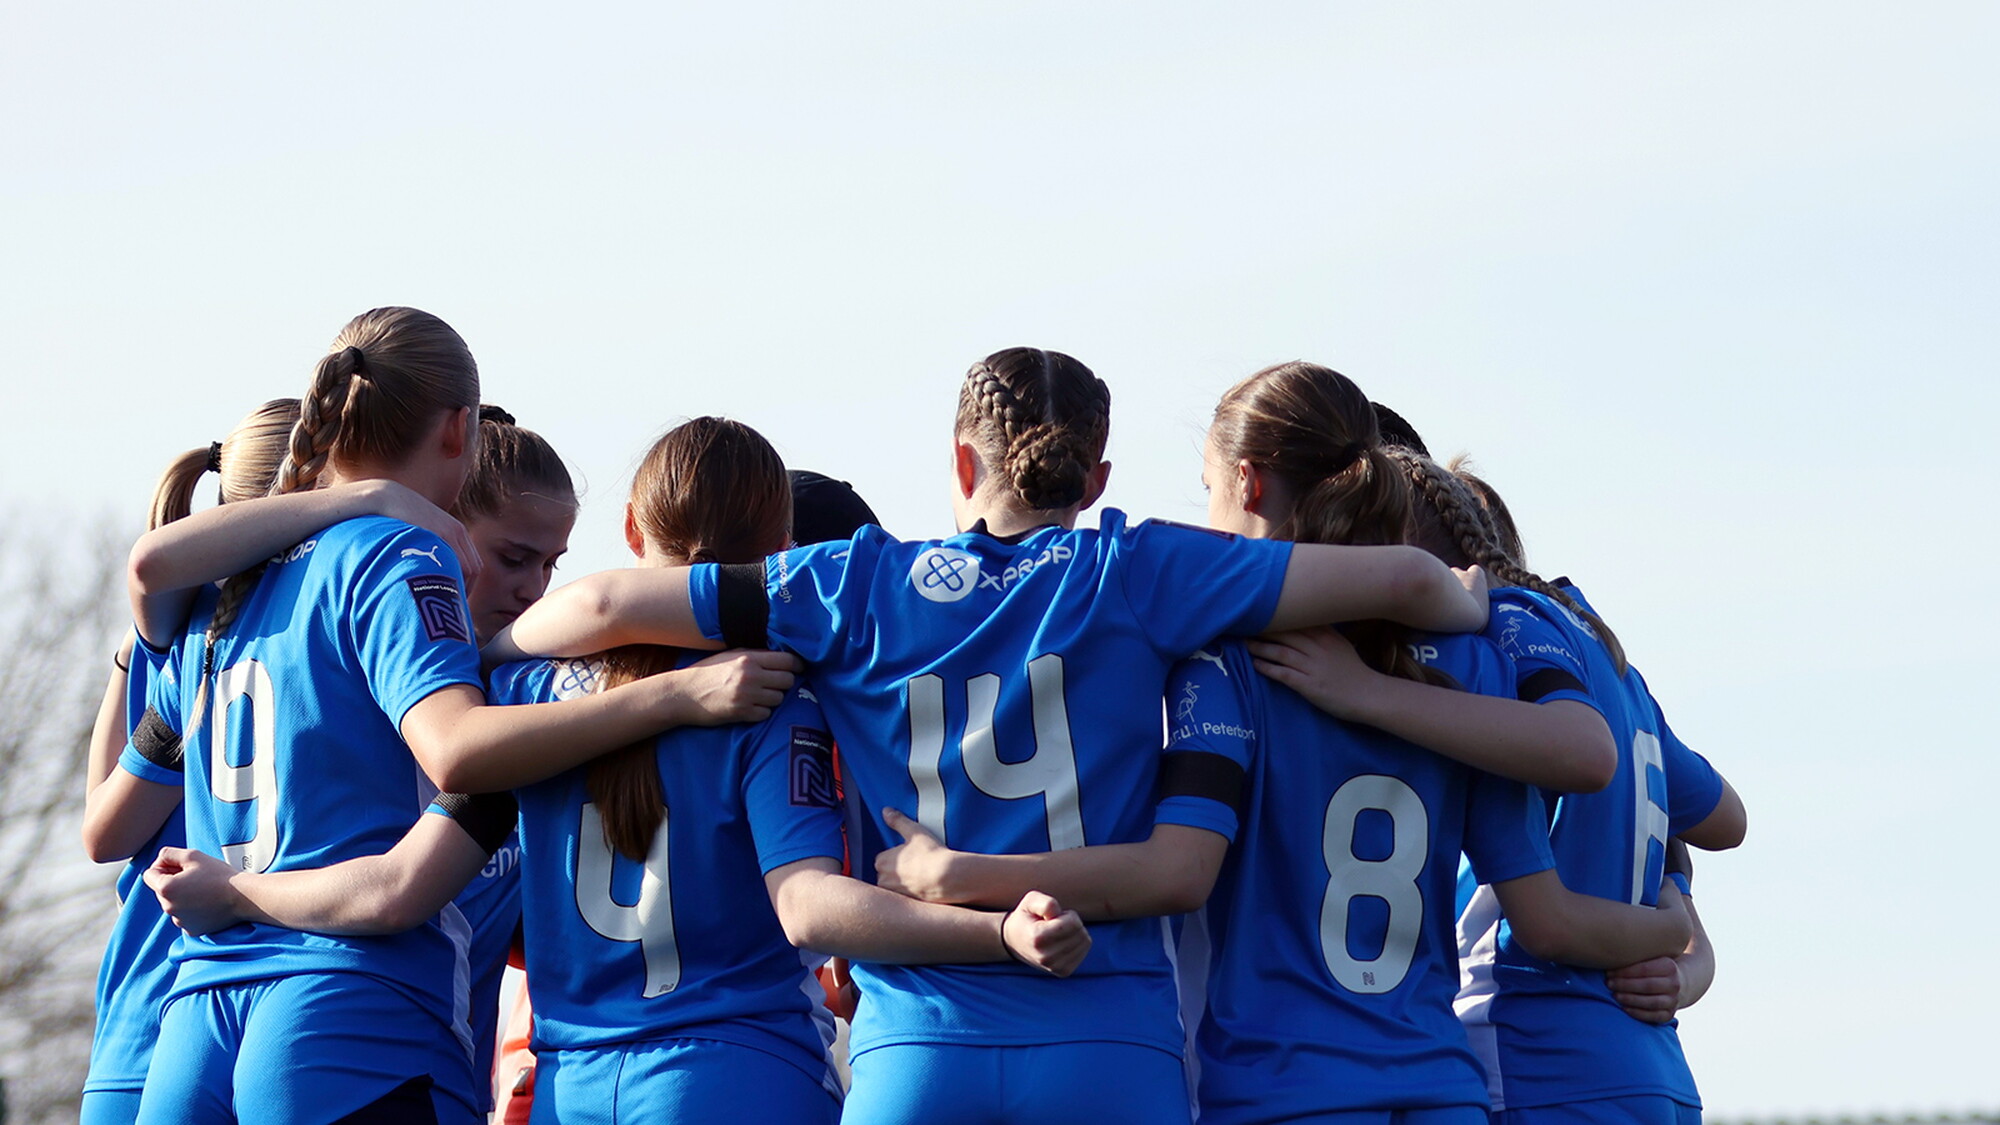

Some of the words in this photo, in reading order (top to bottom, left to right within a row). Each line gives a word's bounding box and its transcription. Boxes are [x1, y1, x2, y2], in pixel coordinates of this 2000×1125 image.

[978, 546, 1073, 591] XPROP
[211, 657, 279, 874] 9
[908, 653, 1088, 852] 14
[575, 802, 682, 999] 4
[1320, 774, 1429, 994] 8
